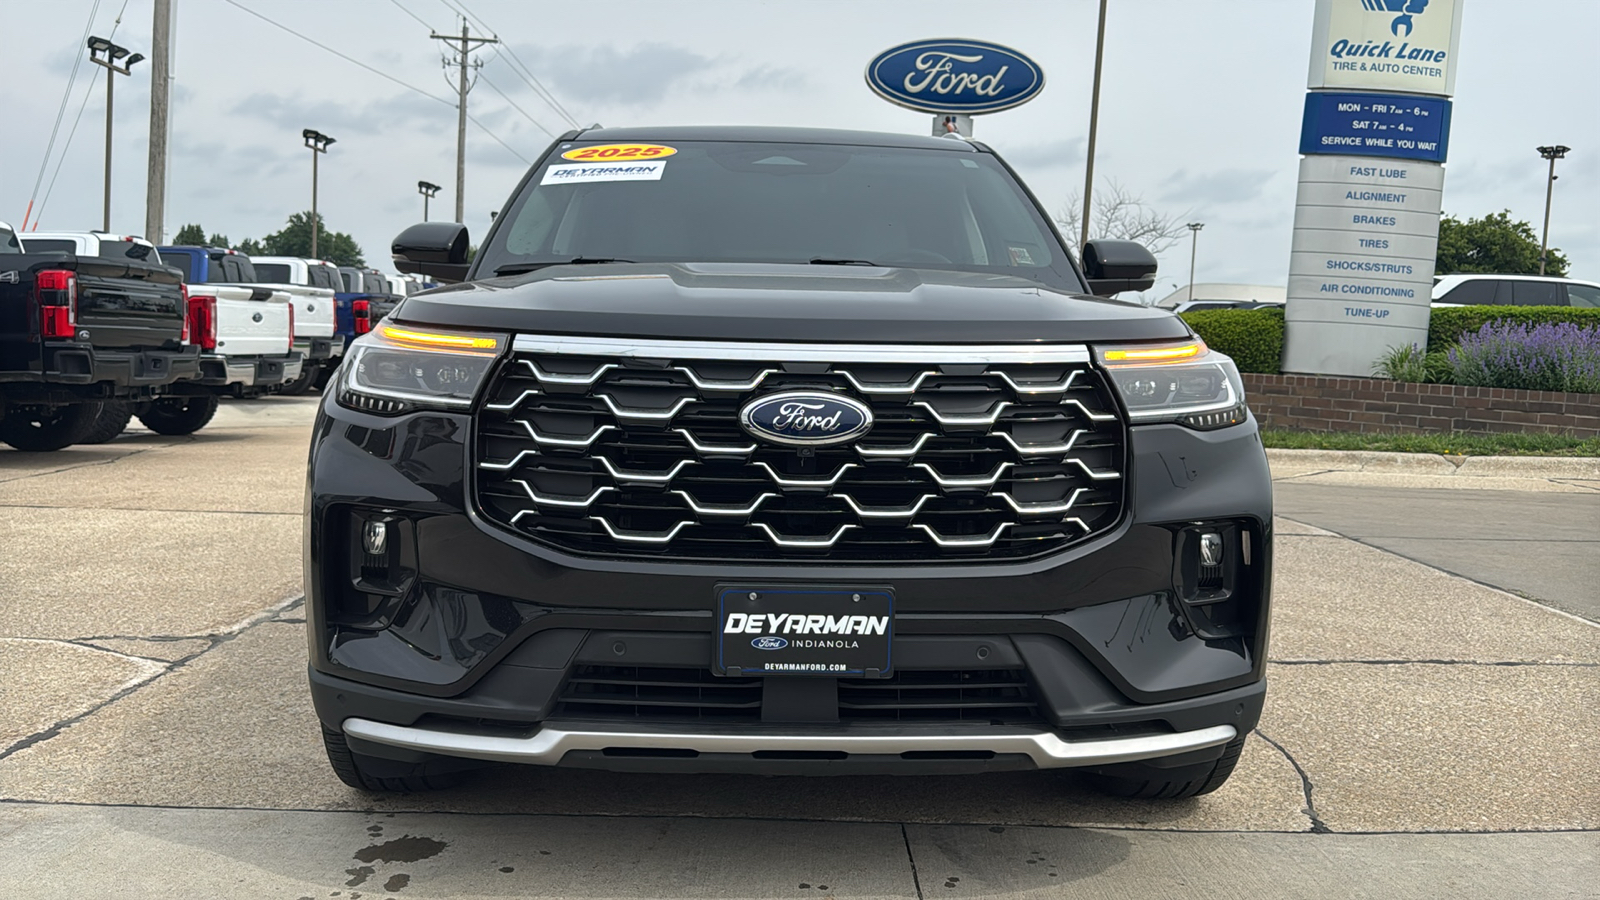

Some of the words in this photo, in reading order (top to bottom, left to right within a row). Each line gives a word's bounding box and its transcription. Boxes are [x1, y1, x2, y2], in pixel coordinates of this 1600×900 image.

[1330, 39, 1395, 58] Quick
[1395, 43, 1446, 63] Lane
[904, 51, 1009, 97] Ford
[1332, 61, 1358, 71] TIRE
[1359, 62, 1367, 71] &
[1369, 63, 1400, 73] AUTO
[1402, 65, 1442, 78] CENTER
[1338, 103, 1361, 112] MON
[1372, 104, 1387, 113] FRI
[1352, 120, 1370, 129] SAT
[1321, 136, 1362, 146] SERVICE
[1365, 138, 1393, 147] WHILE
[1397, 140, 1415, 149] YOU
[1417, 142, 1437, 151] WAIT
[573, 147, 665, 159] 2025
[553, 166, 658, 176] DEYARMAN
[1350, 167, 1377, 176] FAST
[1379, 168, 1407, 178] LUBE
[1345, 191, 1407, 203] ALIGNMENT
[1353, 215, 1396, 226] BRAKES
[1359, 239, 1389, 249] TIRES
[1326, 260, 1413, 274] SHOCKS/STRUTS
[1320, 284, 1339, 293] AIR
[1341, 285, 1414, 298] CONDITIONING
[1344, 307, 1390, 318] TUNE-UP
[772, 402, 842, 431] Ford
[724, 613, 889, 635] DEYARMAN
[758, 638, 781, 648] Ford
[791, 640, 859, 648] INDIANOLA
[765, 663, 846, 671] DEYARMANFORD.COM
